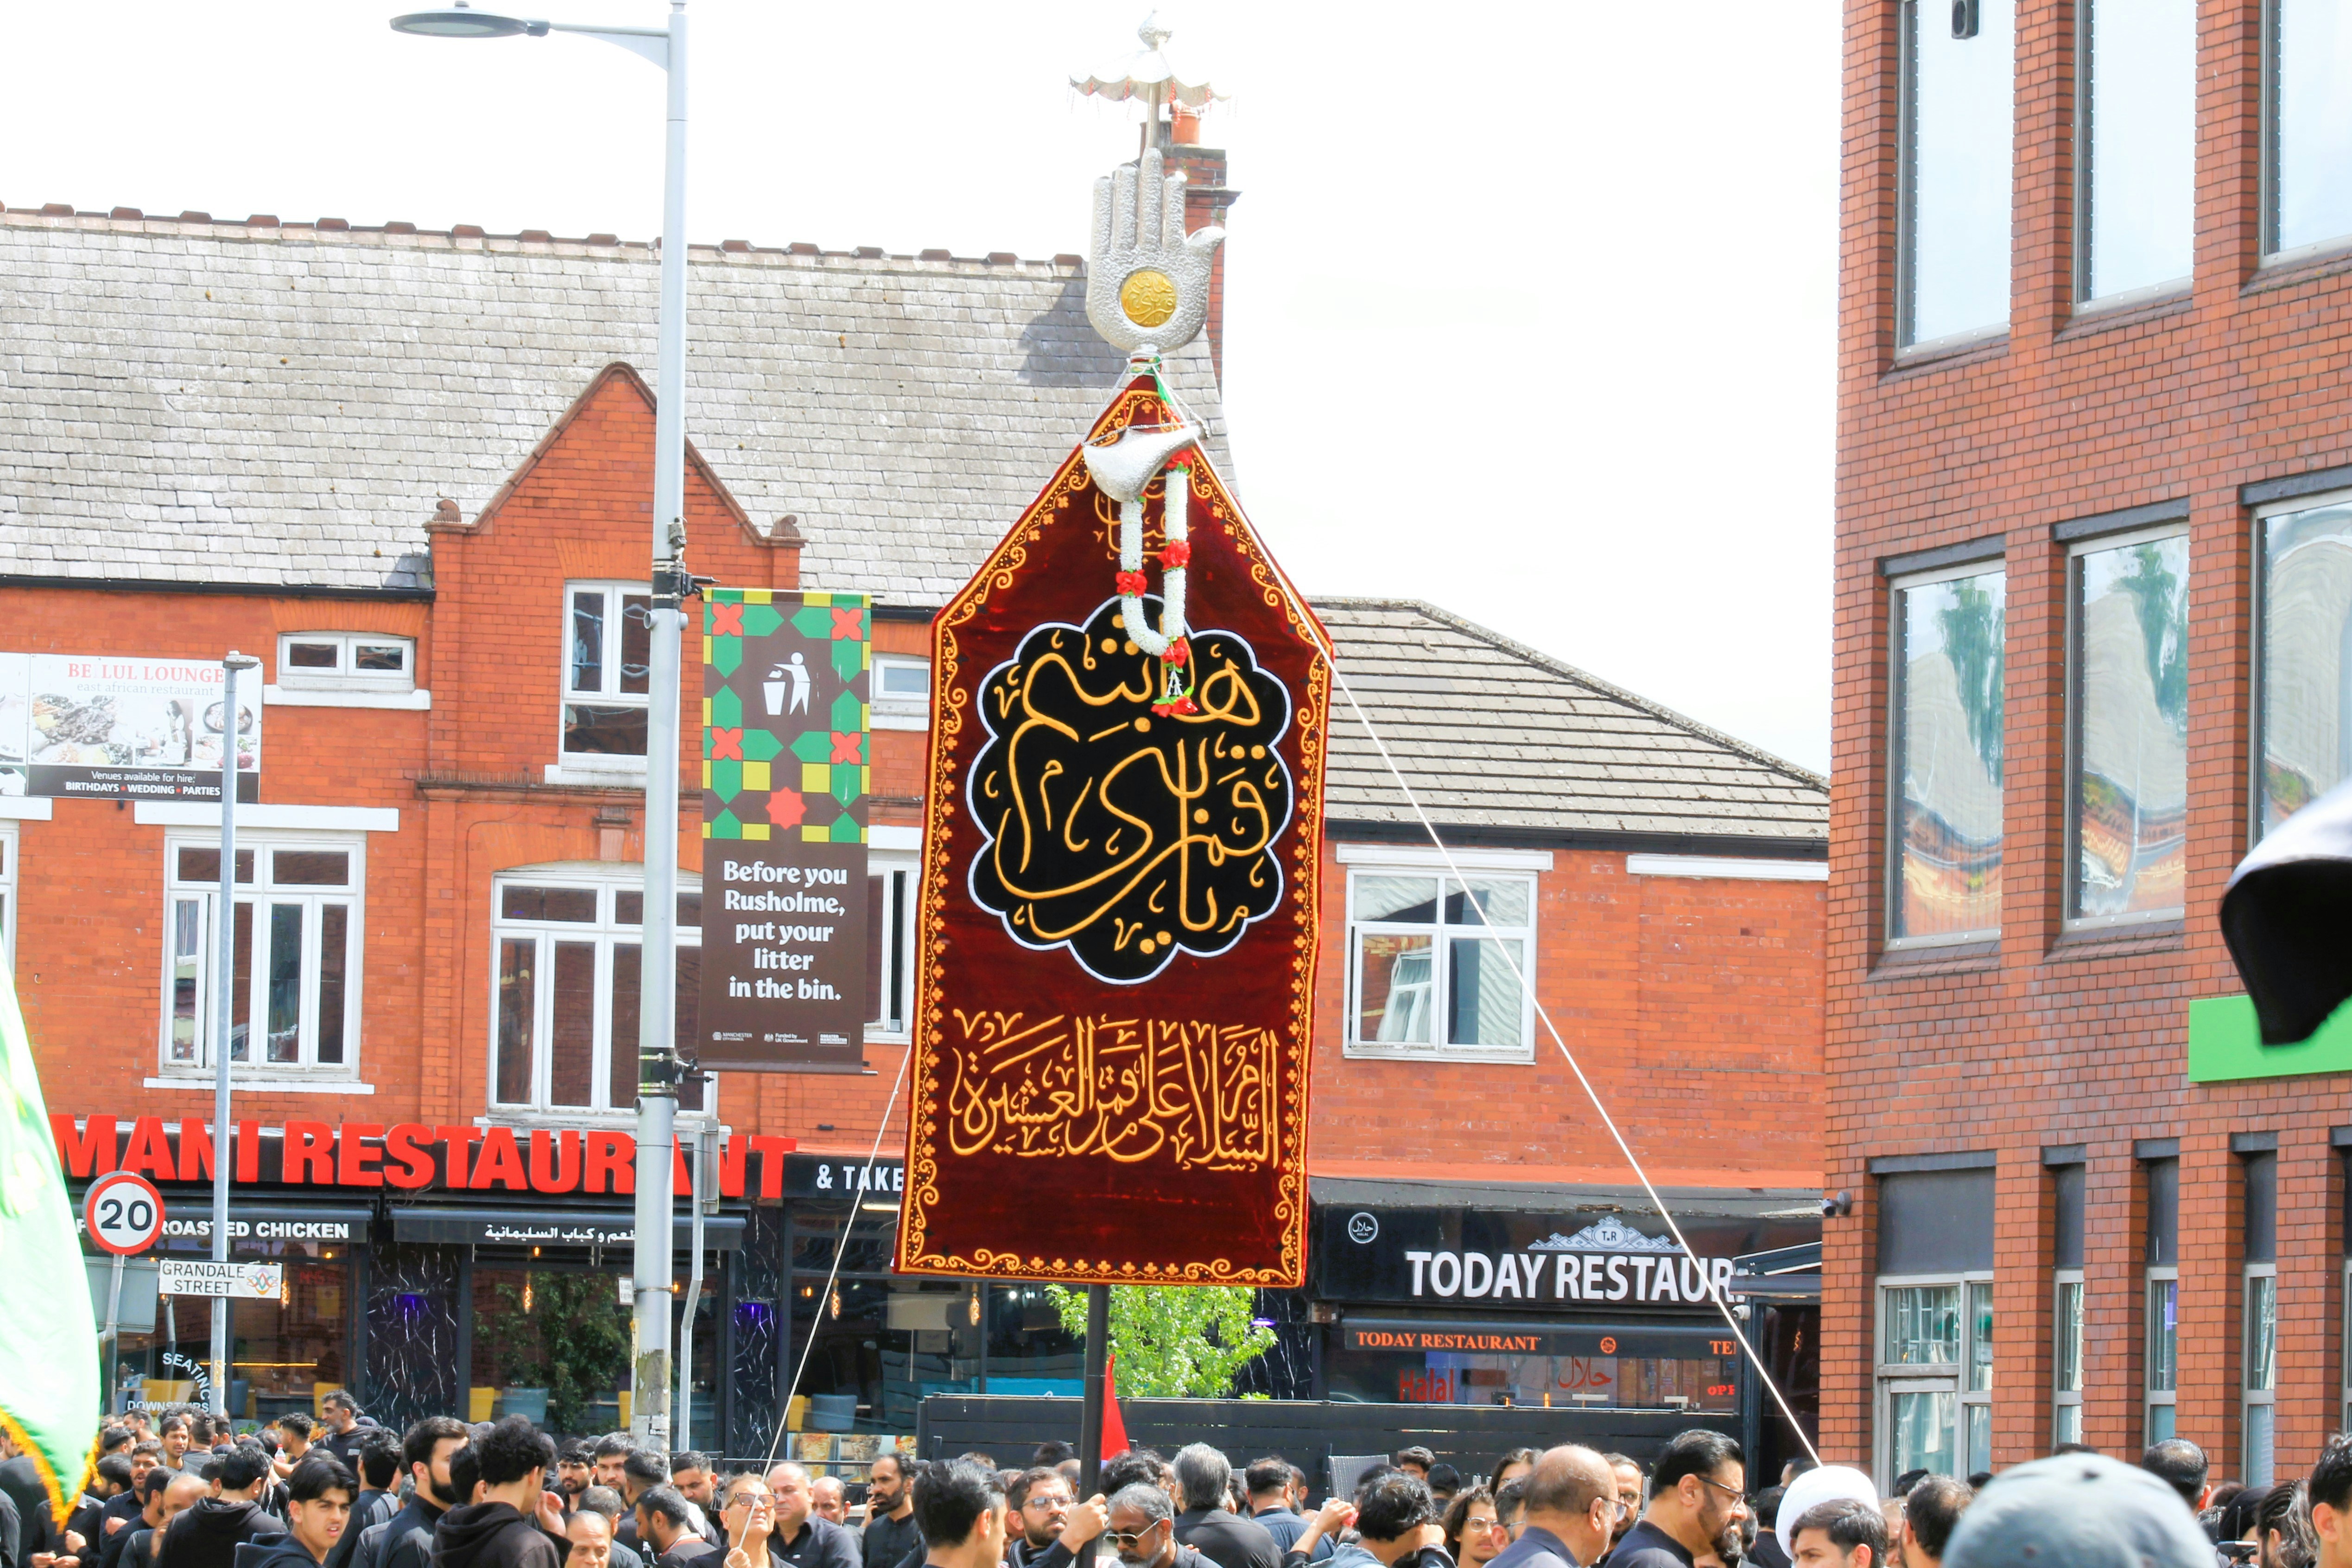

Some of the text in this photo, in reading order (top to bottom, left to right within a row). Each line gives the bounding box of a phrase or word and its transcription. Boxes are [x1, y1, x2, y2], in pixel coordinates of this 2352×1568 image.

[144, 665, 224, 683] LOUNGE
[77, 681, 214, 696] east african restaurant
[91, 770, 196, 784] Venues available for hire:
[65, 781, 221, 796] BIRTHDAYS WEDDING PARTIES
[723, 860, 848, 888] Before you
[724, 889, 846, 917] Rusholme,
[735, 921, 834, 946] put your
[754, 947, 814, 971] litter
[729, 975, 842, 1001] in the bin.
[816, 1163, 833, 1190] &
[101, 1198, 153, 1231] 20
[256, 1221, 349, 1239] CHICKEN
[485, 1224, 558, 1241] السليمانية
[561, 1227, 596, 1243] كباب
[1352, 1220, 1374, 1232] حلال
[597, 1231, 605, 1243] و
[162, 1263, 246, 1279] GRANDALE
[1404, 1251, 1746, 1303] TODAY RESTAUR
[174, 1279, 233, 1294] STREET
[1356, 1331, 1539, 1351] TODAY RESTAURANT
[1558, 1355, 1613, 1389] حلال
[1398, 1368, 1454, 1403] Halal
